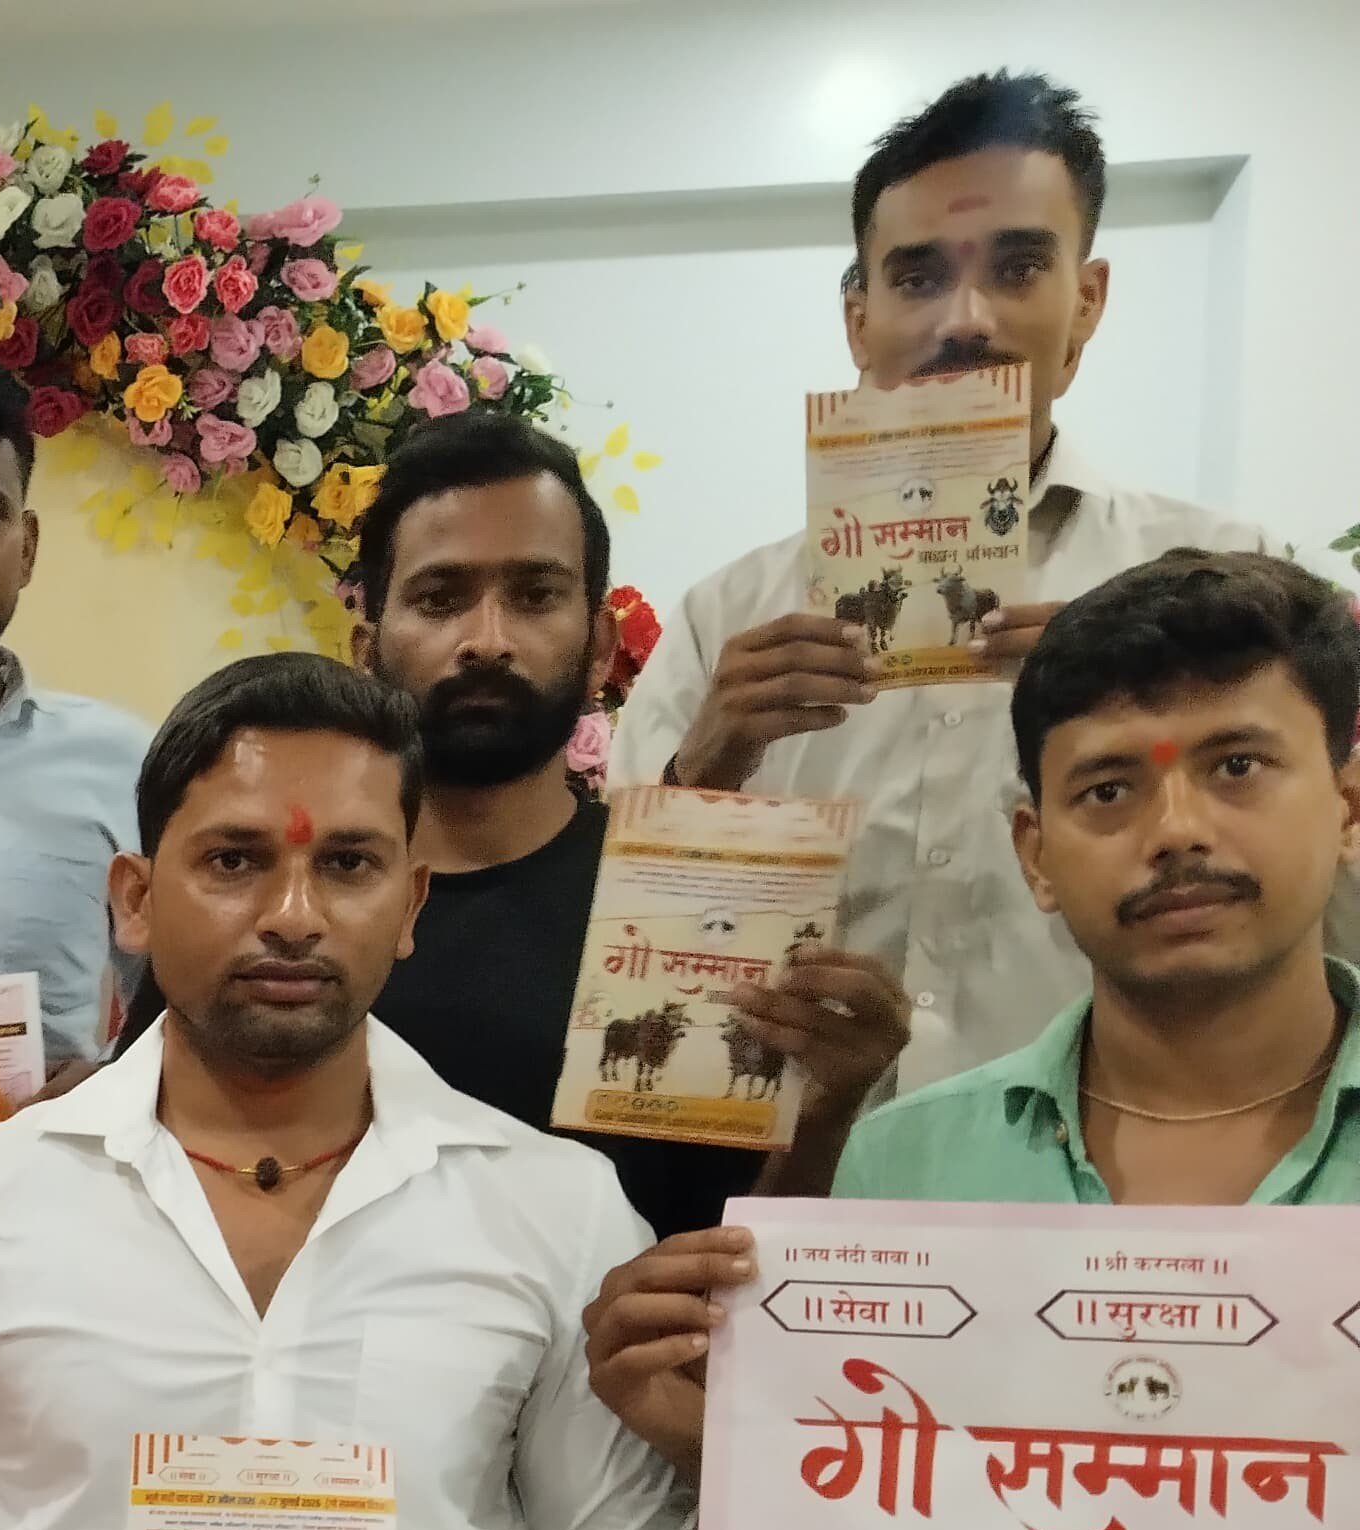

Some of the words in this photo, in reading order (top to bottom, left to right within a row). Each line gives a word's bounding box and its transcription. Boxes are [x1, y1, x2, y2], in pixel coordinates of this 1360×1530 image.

[868, 515, 972, 560] सम्मान
[966, 544, 1020, 563] अभियान
[654, 949, 773, 995] सम्मान
[803, 1247, 829, 1262] जय
[835, 1243, 865, 1264] नंदी
[1105, 1250, 1128, 1271] श्री
[829, 1290, 890, 1324] सेवा
[1104, 1301, 1201, 1339] सुरक्षा
